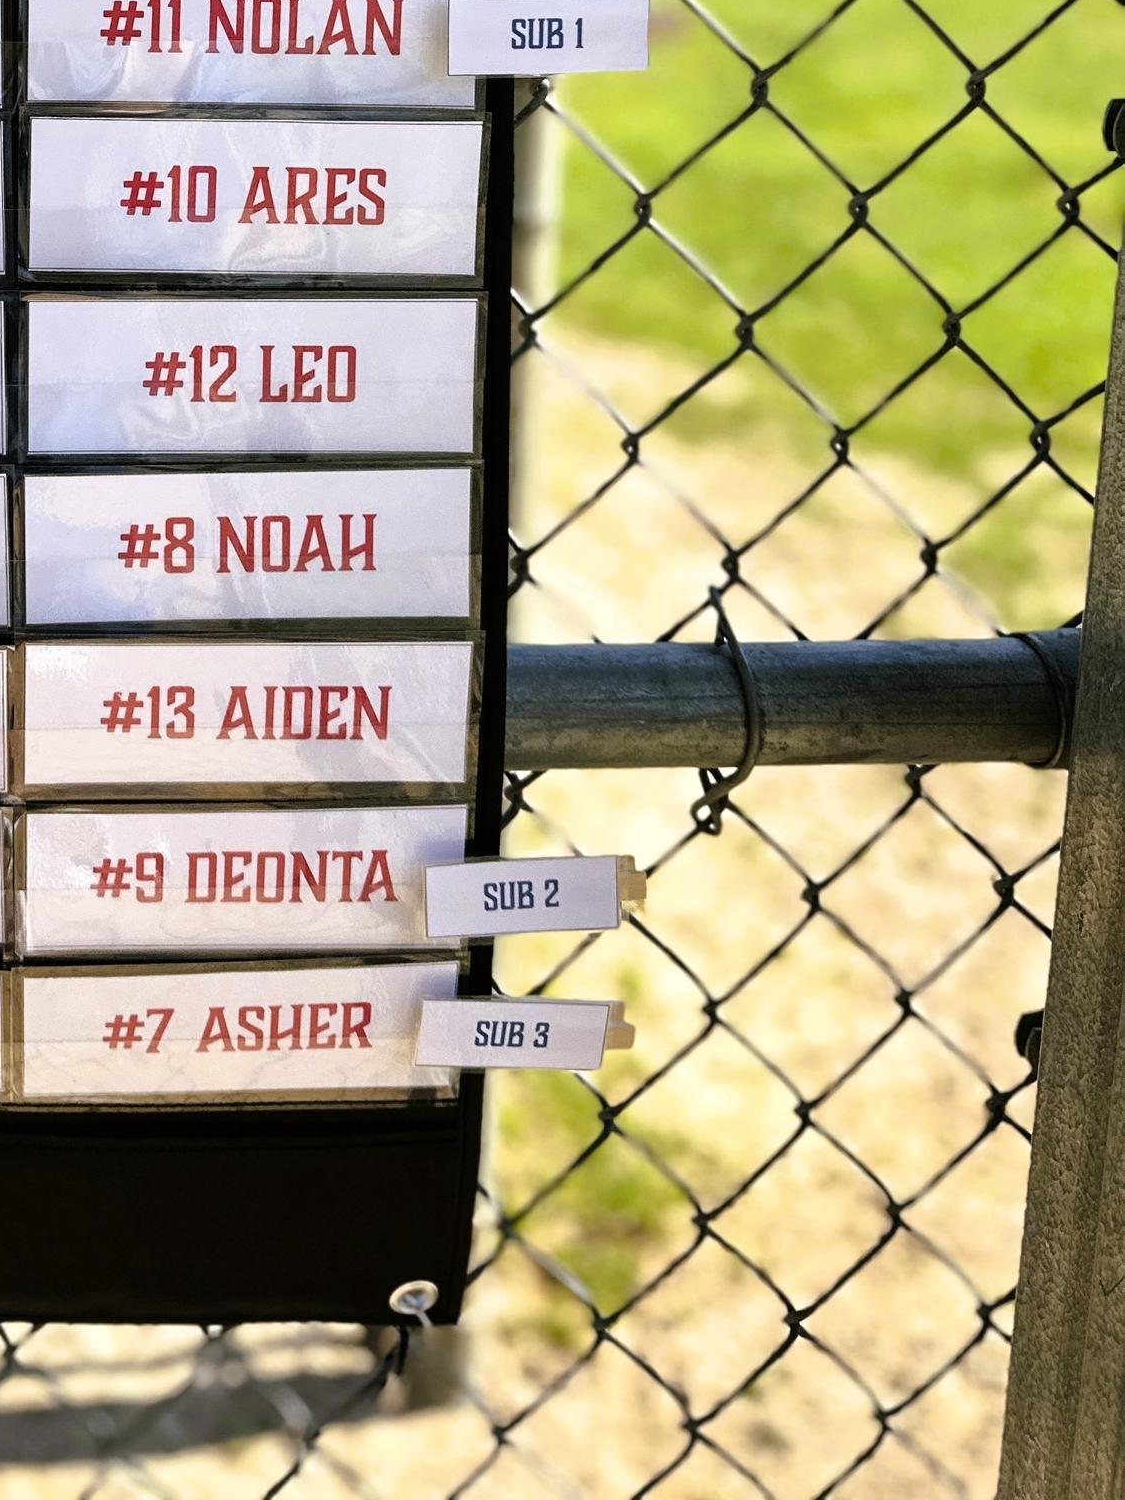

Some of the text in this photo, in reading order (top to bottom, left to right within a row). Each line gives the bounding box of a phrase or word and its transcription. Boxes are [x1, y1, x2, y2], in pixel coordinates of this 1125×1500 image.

[511, 17, 583, 49] SUB 1
[119, 164, 387, 225] #10 ARES
[142, 344, 357, 403] #12 LEO
[117, 514, 376, 573] #8 NOAH
[99, 685, 393, 740] #13 AIDEN
[89, 849, 399, 903] #9 DEONTA
[483, 878, 560, 911] SUB 2
[101, 1001, 373, 1053] #7 ASHER
[474, 1020, 550, 1048] SUB 3
